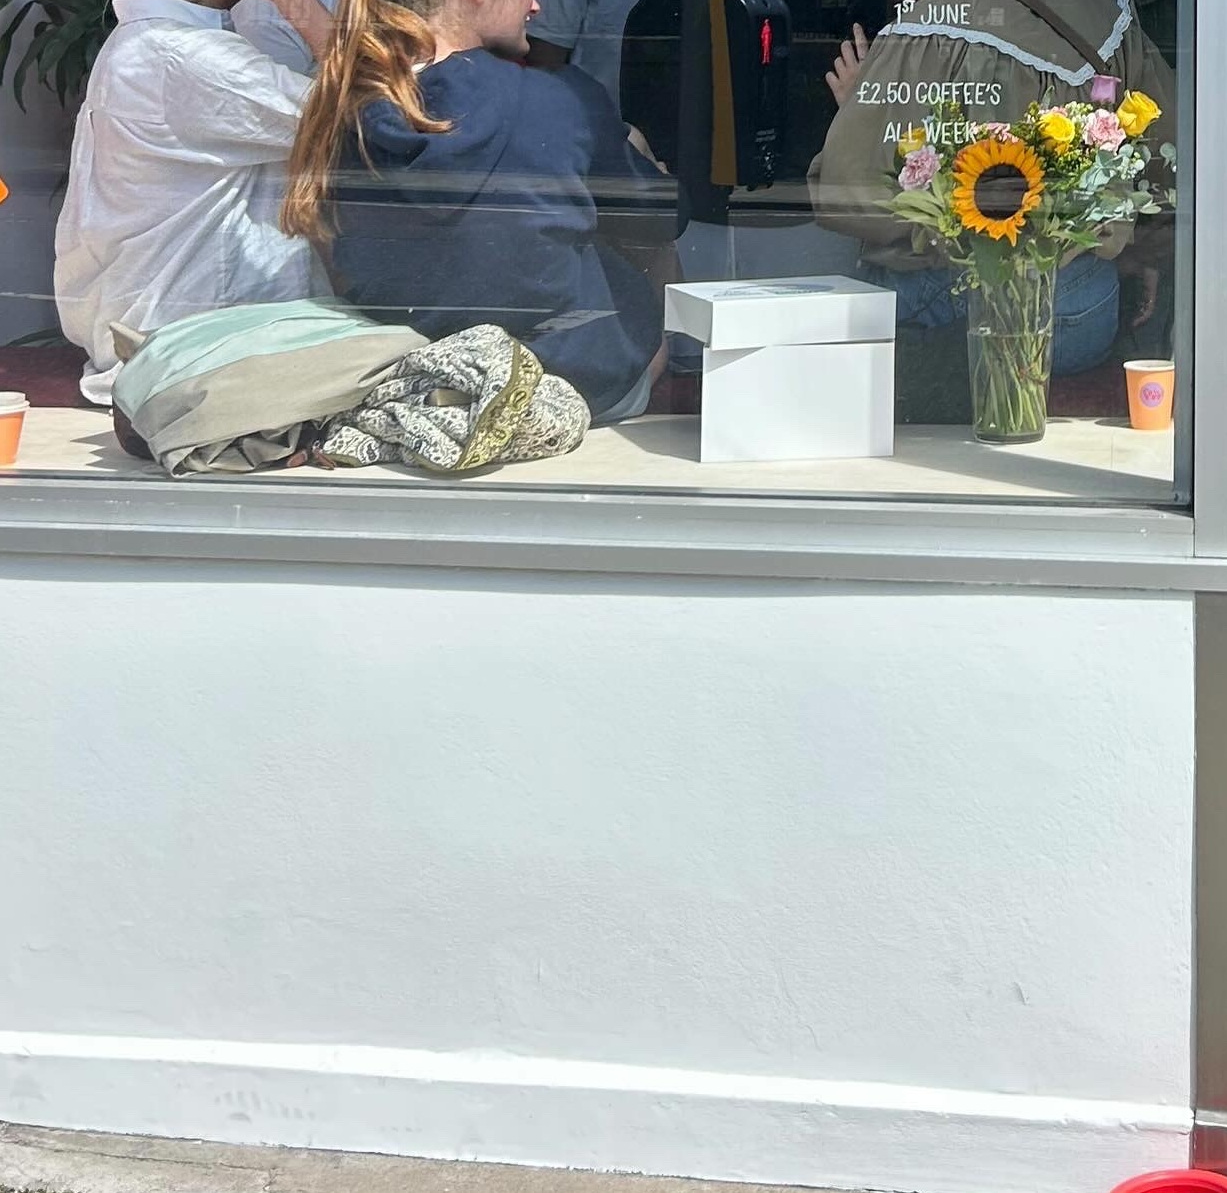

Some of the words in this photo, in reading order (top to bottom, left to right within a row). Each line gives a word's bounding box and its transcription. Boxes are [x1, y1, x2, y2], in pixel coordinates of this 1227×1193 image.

[893, 0, 916, 25] 1ST
[920, 3, 972, 25] JUNE
[856, 81, 911, 105] £2.50
[883, 121, 919, 143] ALL
[921, 121, 977, 145] WEEK
